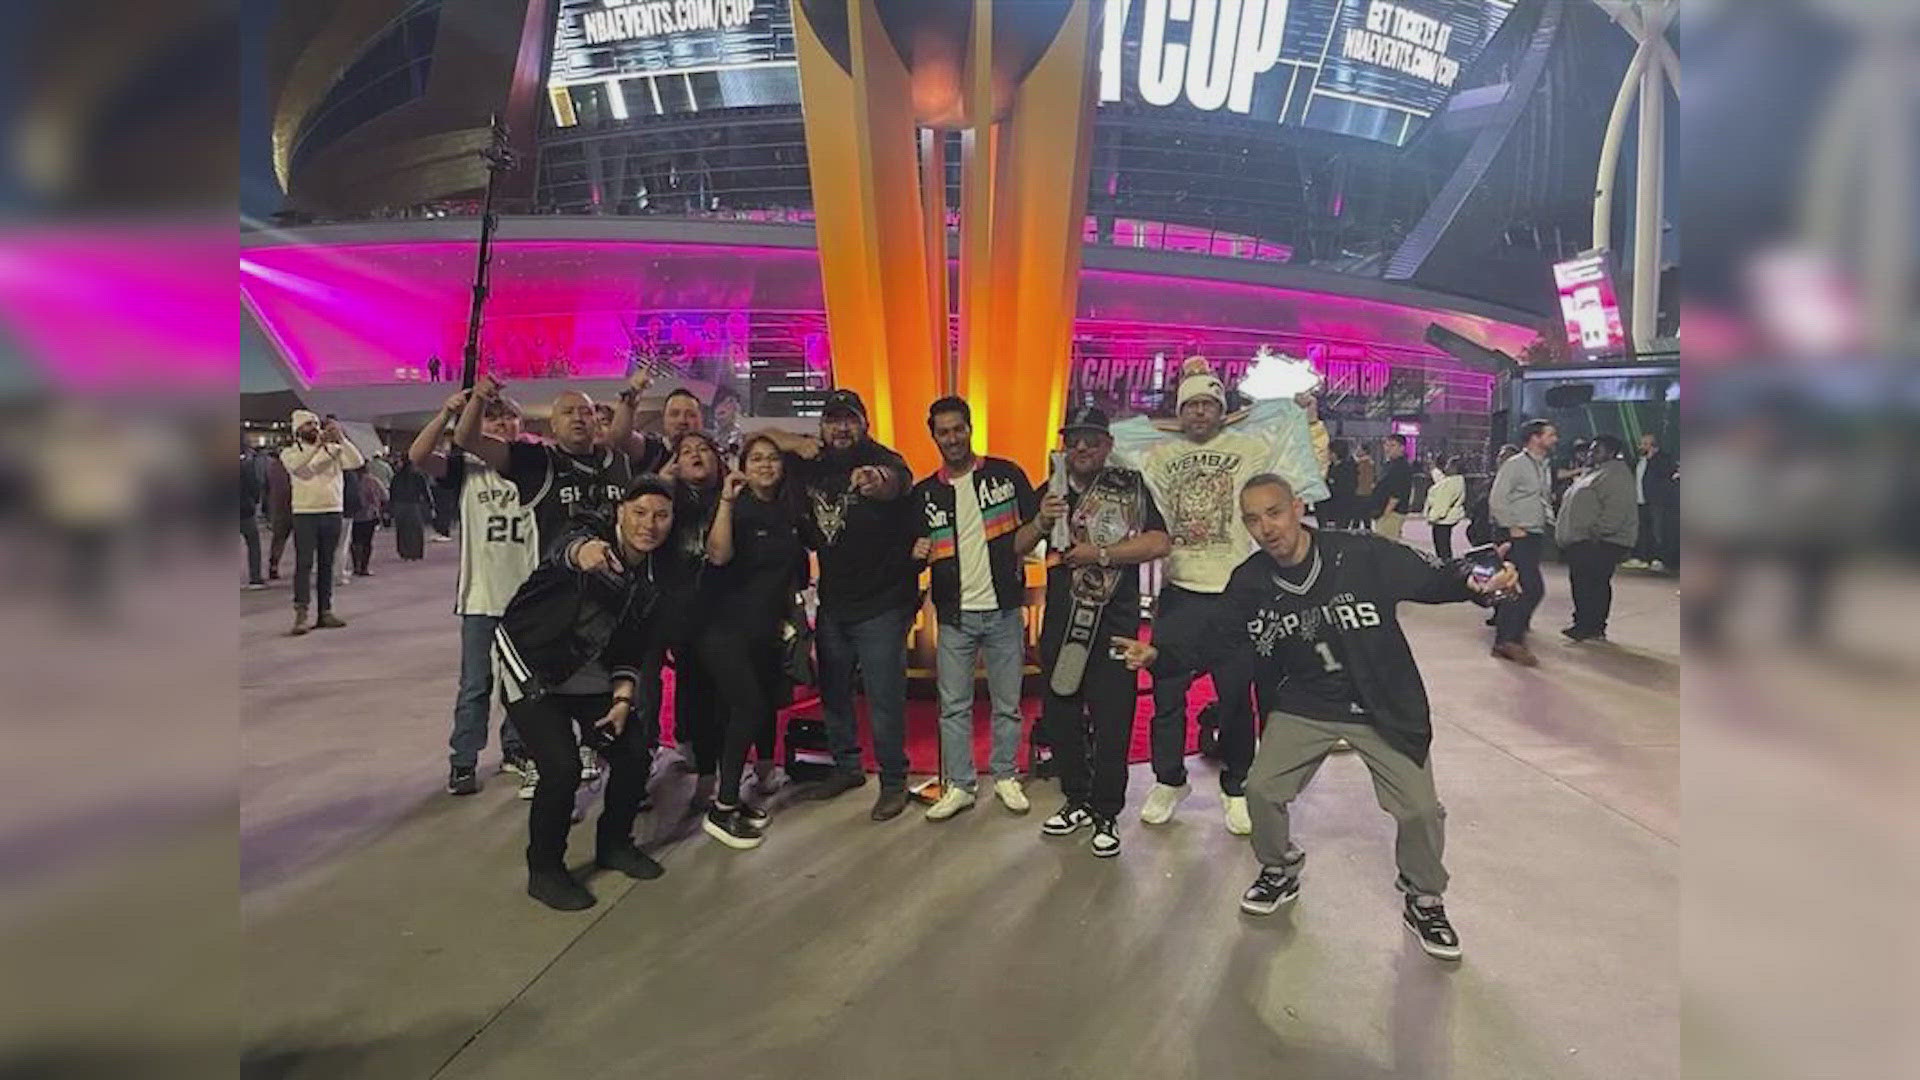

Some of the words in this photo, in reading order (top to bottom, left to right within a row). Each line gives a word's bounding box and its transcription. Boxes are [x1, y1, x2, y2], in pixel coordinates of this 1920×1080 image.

[584, 2, 755, 44] NBAEVENTS.COM/CUP
[1391, 6, 1440, 50] TICKETS
[1138, 0, 1289, 114] CUP
[1082, 357, 1181, 395] CAPTUE
[1315, 642, 1343, 672] 1
